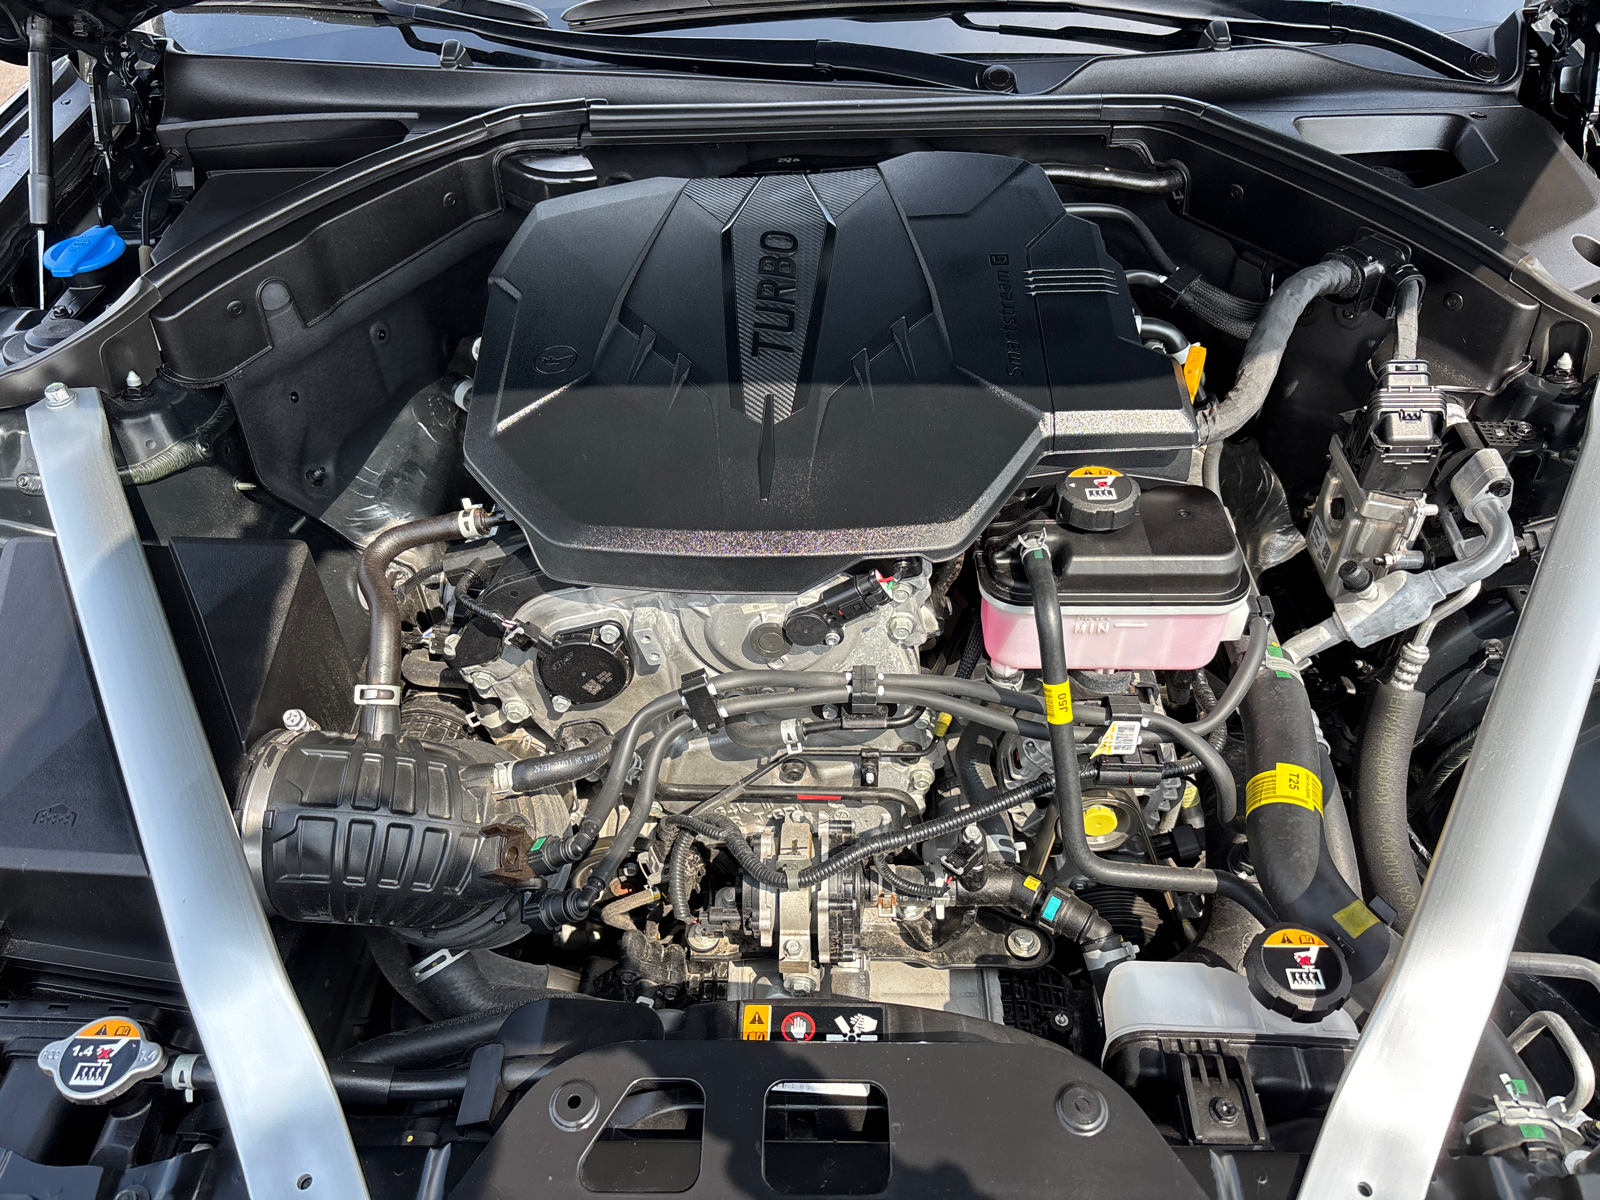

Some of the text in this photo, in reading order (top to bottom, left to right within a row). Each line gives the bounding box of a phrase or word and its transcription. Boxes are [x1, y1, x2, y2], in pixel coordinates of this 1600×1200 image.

[752, 230, 799, 358] TURBO
[997, 268, 1025, 380] Smartstream
[1073, 622, 1110, 635] MIN
[1057, 692, 1069, 713] J50
[1288, 773, 1300, 791] T25
[72, 1044, 95, 1057] 1.4
